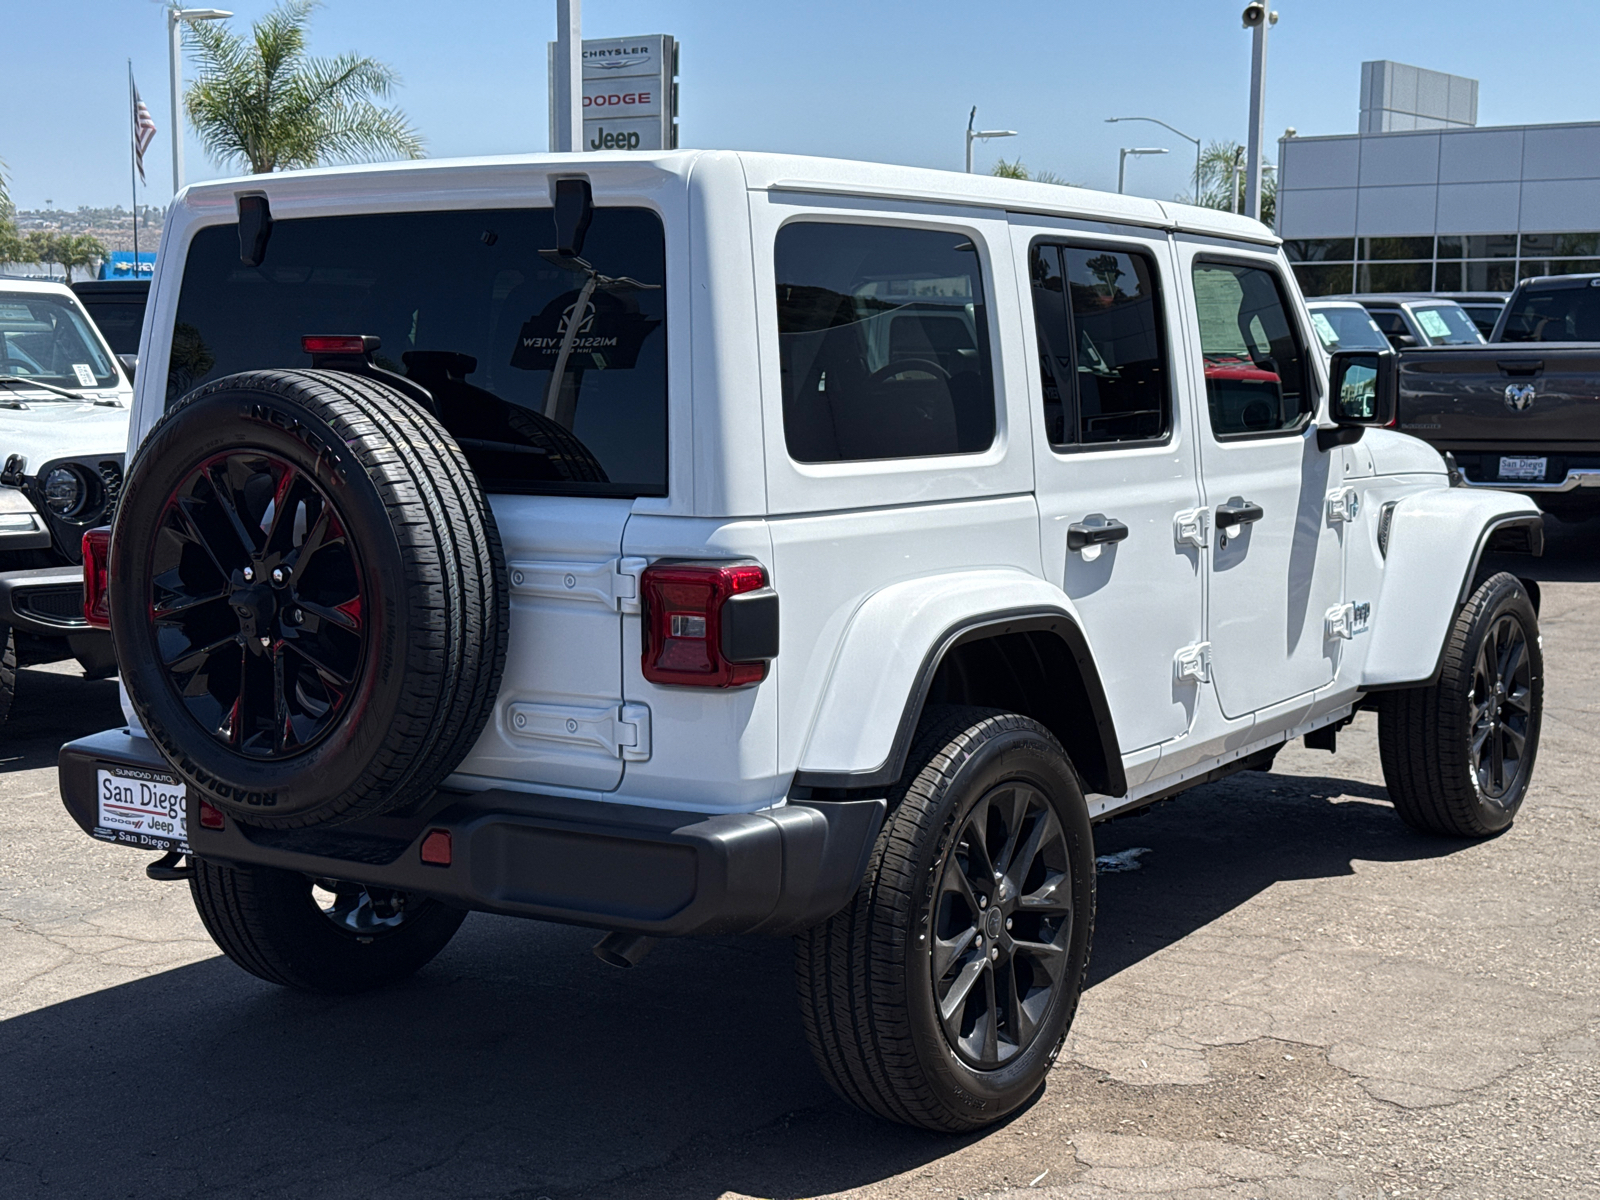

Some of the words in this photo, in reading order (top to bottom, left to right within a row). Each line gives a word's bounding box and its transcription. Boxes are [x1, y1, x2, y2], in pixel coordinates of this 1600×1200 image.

[582, 46, 649, 58] CHRYSLER
[582, 92, 651, 107] DODGE
[590, 127, 641, 150] Jeep
[251, 403, 342, 471] NEXEN
[1501, 459, 1517, 468] San
[1519, 459, 1543, 471] Diego
[115, 768, 152, 779] SUNROAD
[153, 773, 173, 782] AUTO
[178, 758, 278, 806] ROADIAN
[102, 777, 135, 804] San
[139, 782, 187, 820] Diego
[147, 815, 174, 834] Jeep
[118, 831, 138, 843] San
[140, 834, 170, 850] Diego
